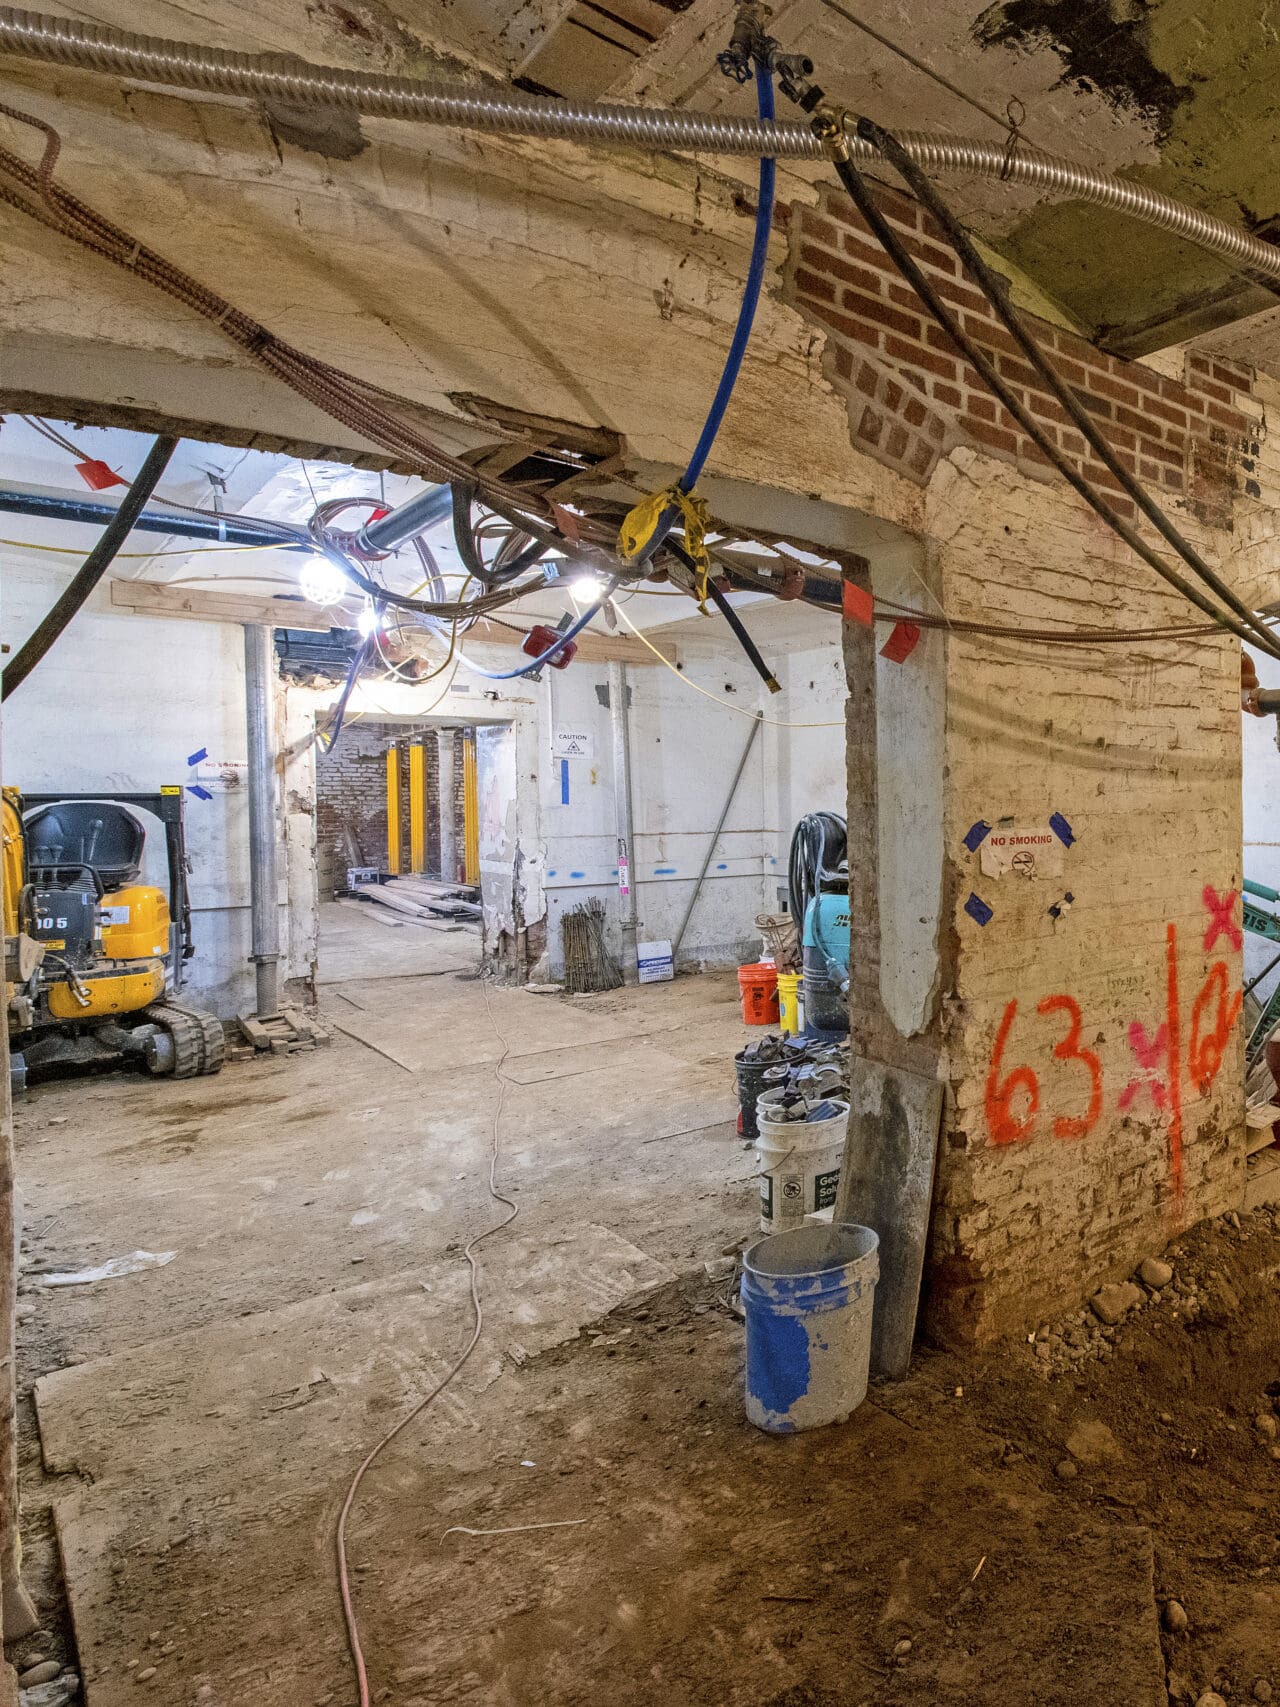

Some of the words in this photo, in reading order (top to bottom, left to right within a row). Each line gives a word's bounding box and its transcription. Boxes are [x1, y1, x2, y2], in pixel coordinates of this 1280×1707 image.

[990, 837, 1006, 846] NO
[1009, 834, 1053, 846] SMOKING
[985, 996, 1103, 1143] 63
